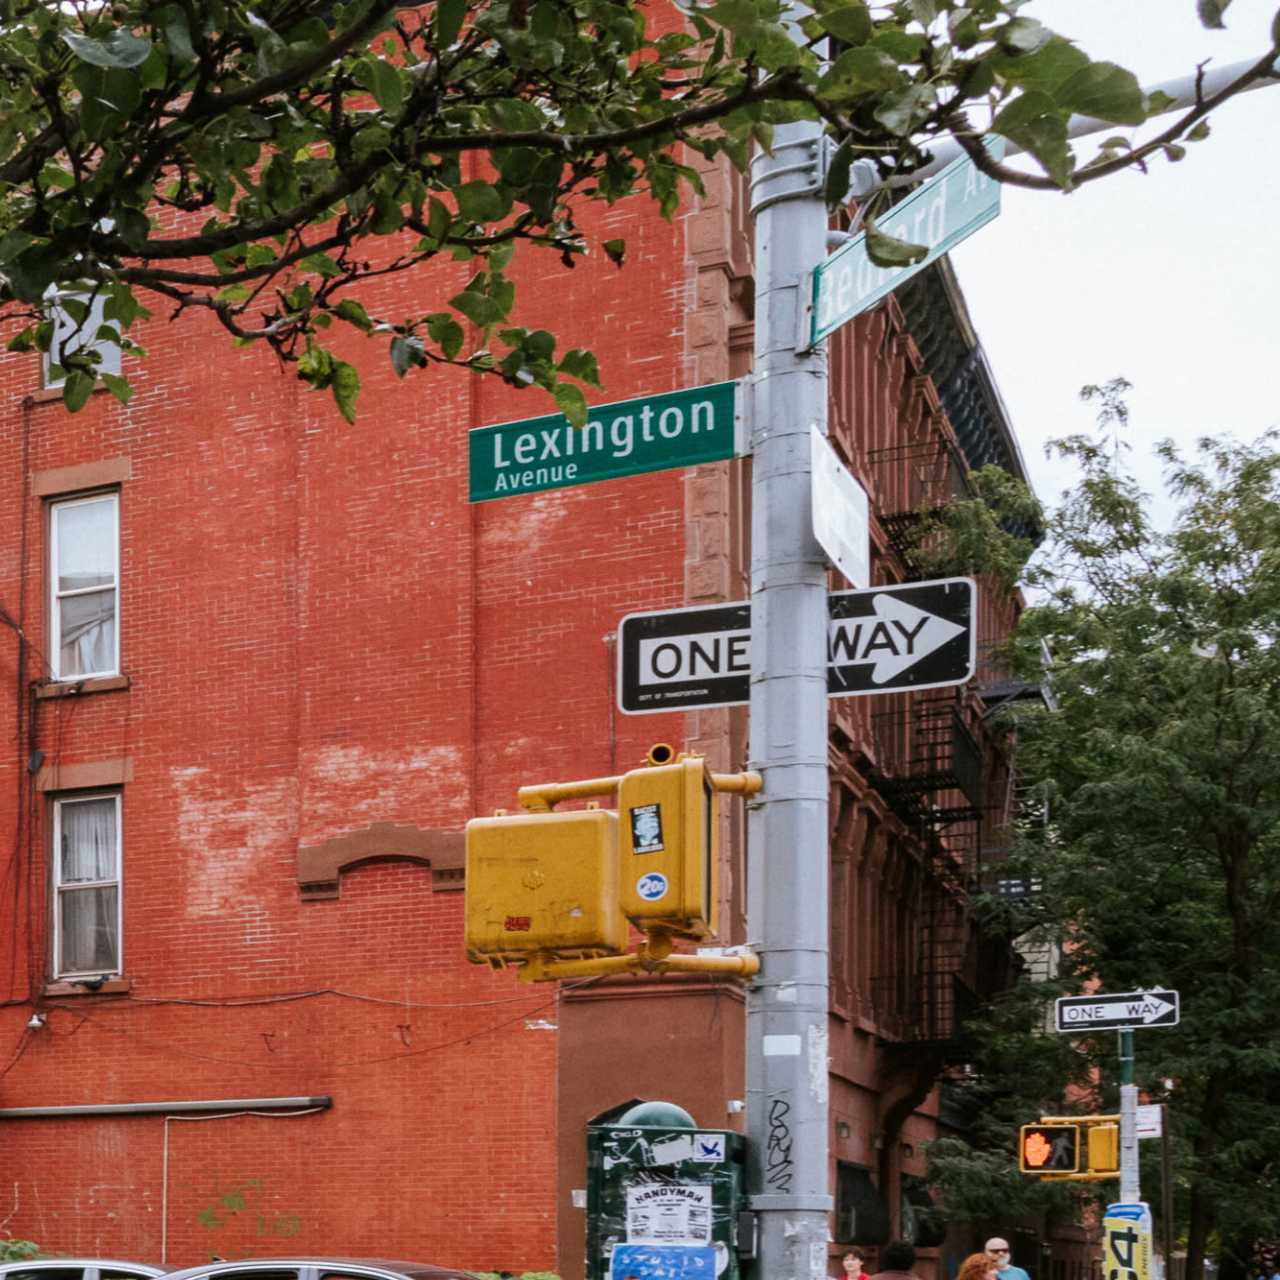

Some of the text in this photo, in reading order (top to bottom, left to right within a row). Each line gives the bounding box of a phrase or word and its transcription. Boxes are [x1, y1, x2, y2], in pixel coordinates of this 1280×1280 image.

[492, 398, 716, 468] Lexington
[494, 460, 578, 491] Avenue
[650, 615, 929, 679] ONE WAY
[1067, 1002, 1163, 1020] ONE WAY
[635, 1188, 704, 1204] HANDYMAN
